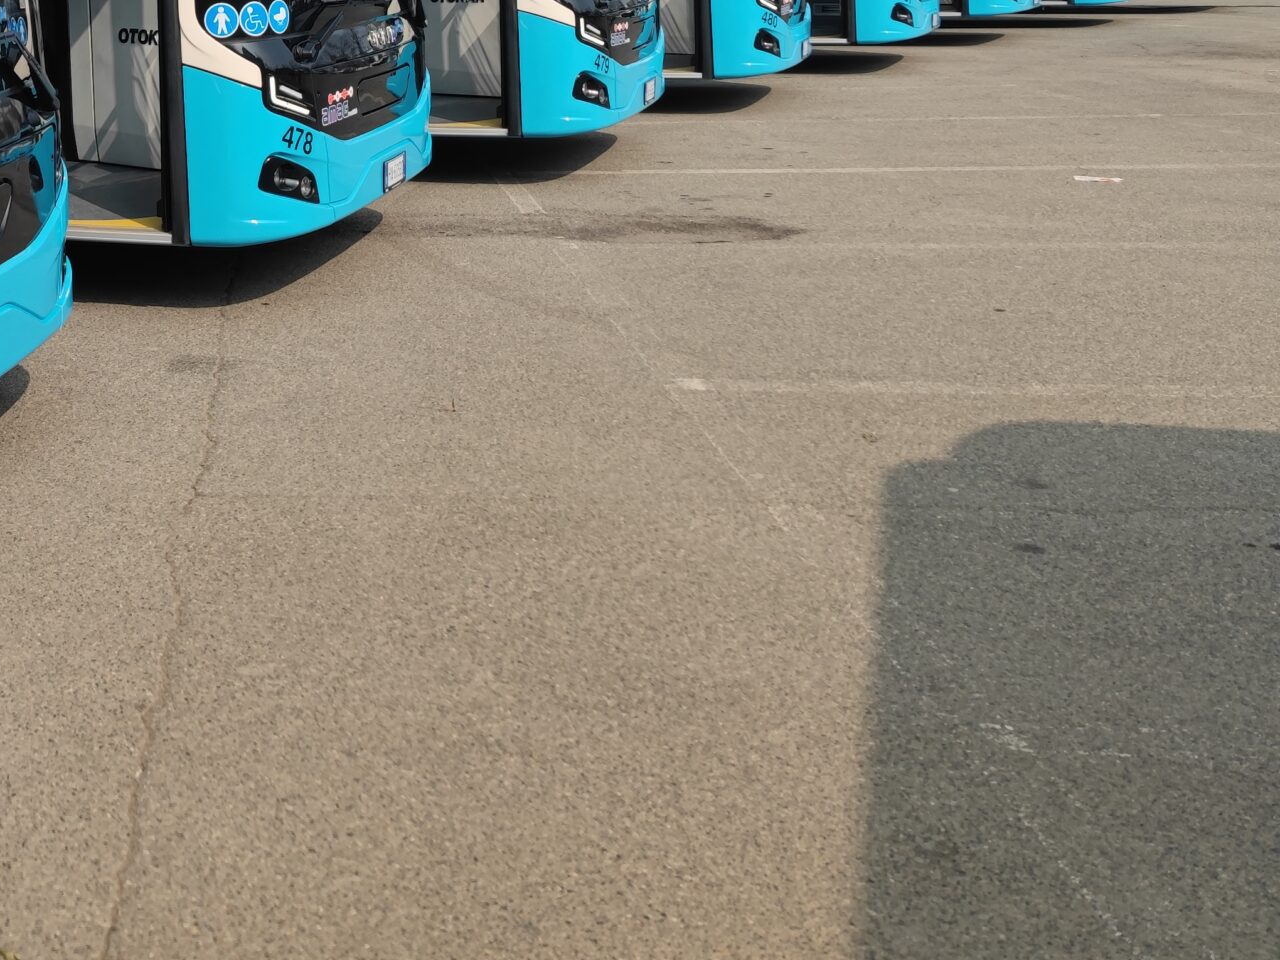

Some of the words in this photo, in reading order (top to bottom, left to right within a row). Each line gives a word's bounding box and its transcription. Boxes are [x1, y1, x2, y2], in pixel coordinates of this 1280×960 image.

[761, 11, 778, 28] 480
[118, 27, 161, 46] OTOK
[594, 54, 610, 74] 479
[282, 125, 314, 155] 478
